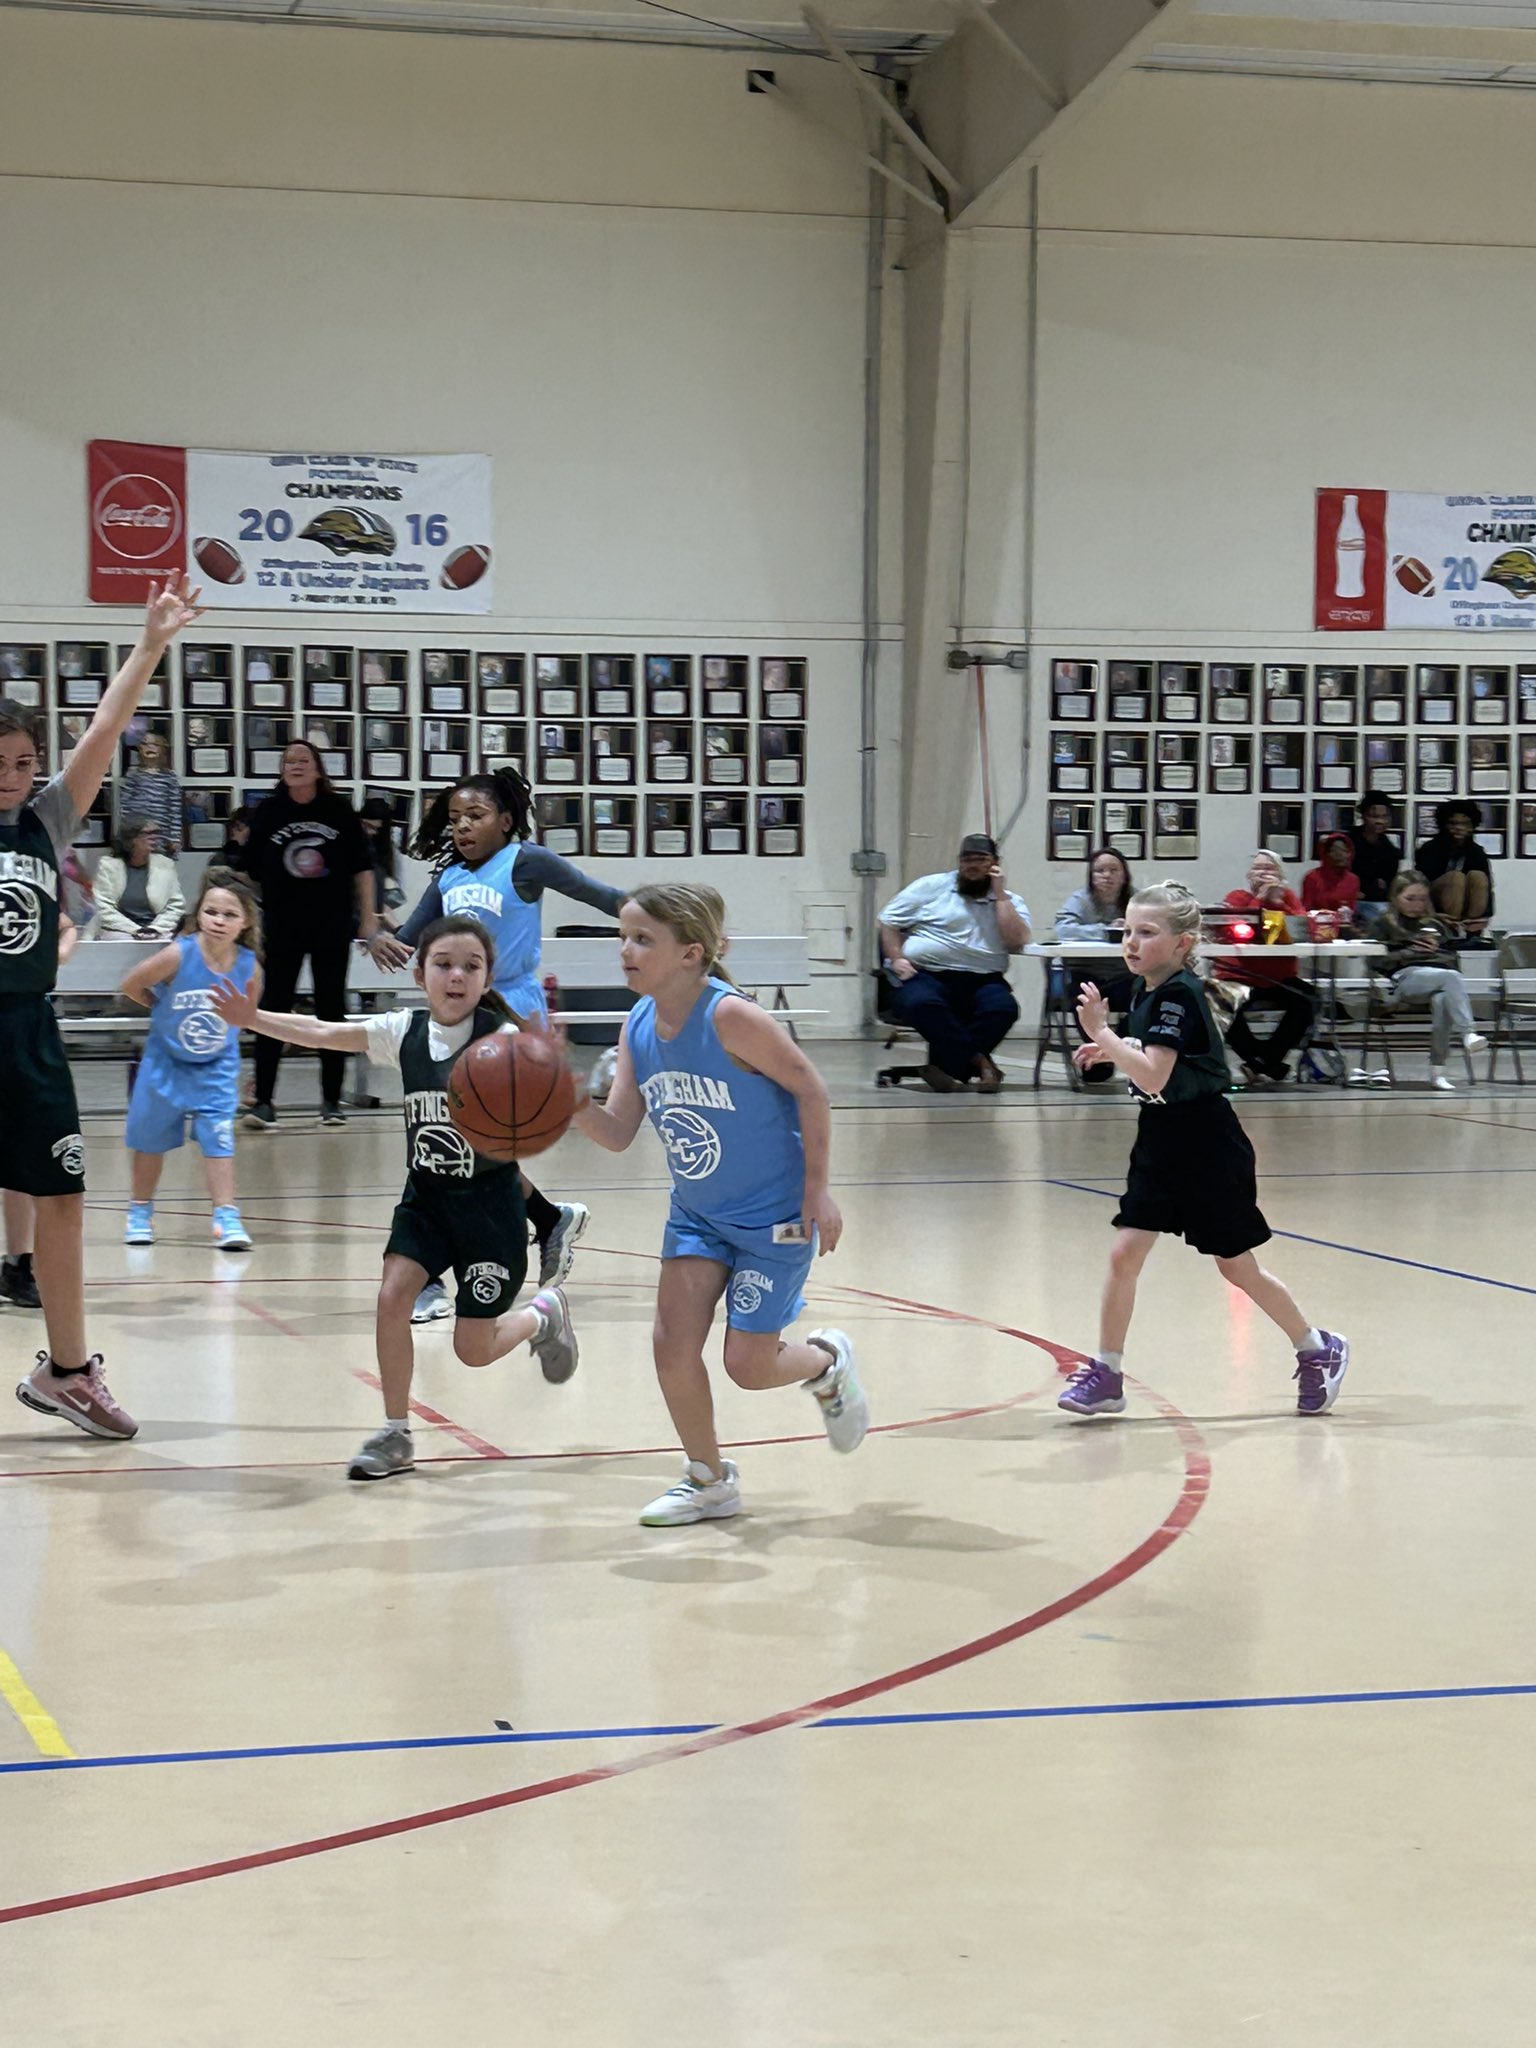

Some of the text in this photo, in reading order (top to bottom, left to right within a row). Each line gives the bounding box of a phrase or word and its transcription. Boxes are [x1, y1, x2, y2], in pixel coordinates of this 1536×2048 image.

[285, 483, 403, 501] CHAMPIONS
[238, 508, 447, 547] 20 16
[1466, 523, 1536, 543] CHAMP
[1444, 556, 1477, 591] 20
